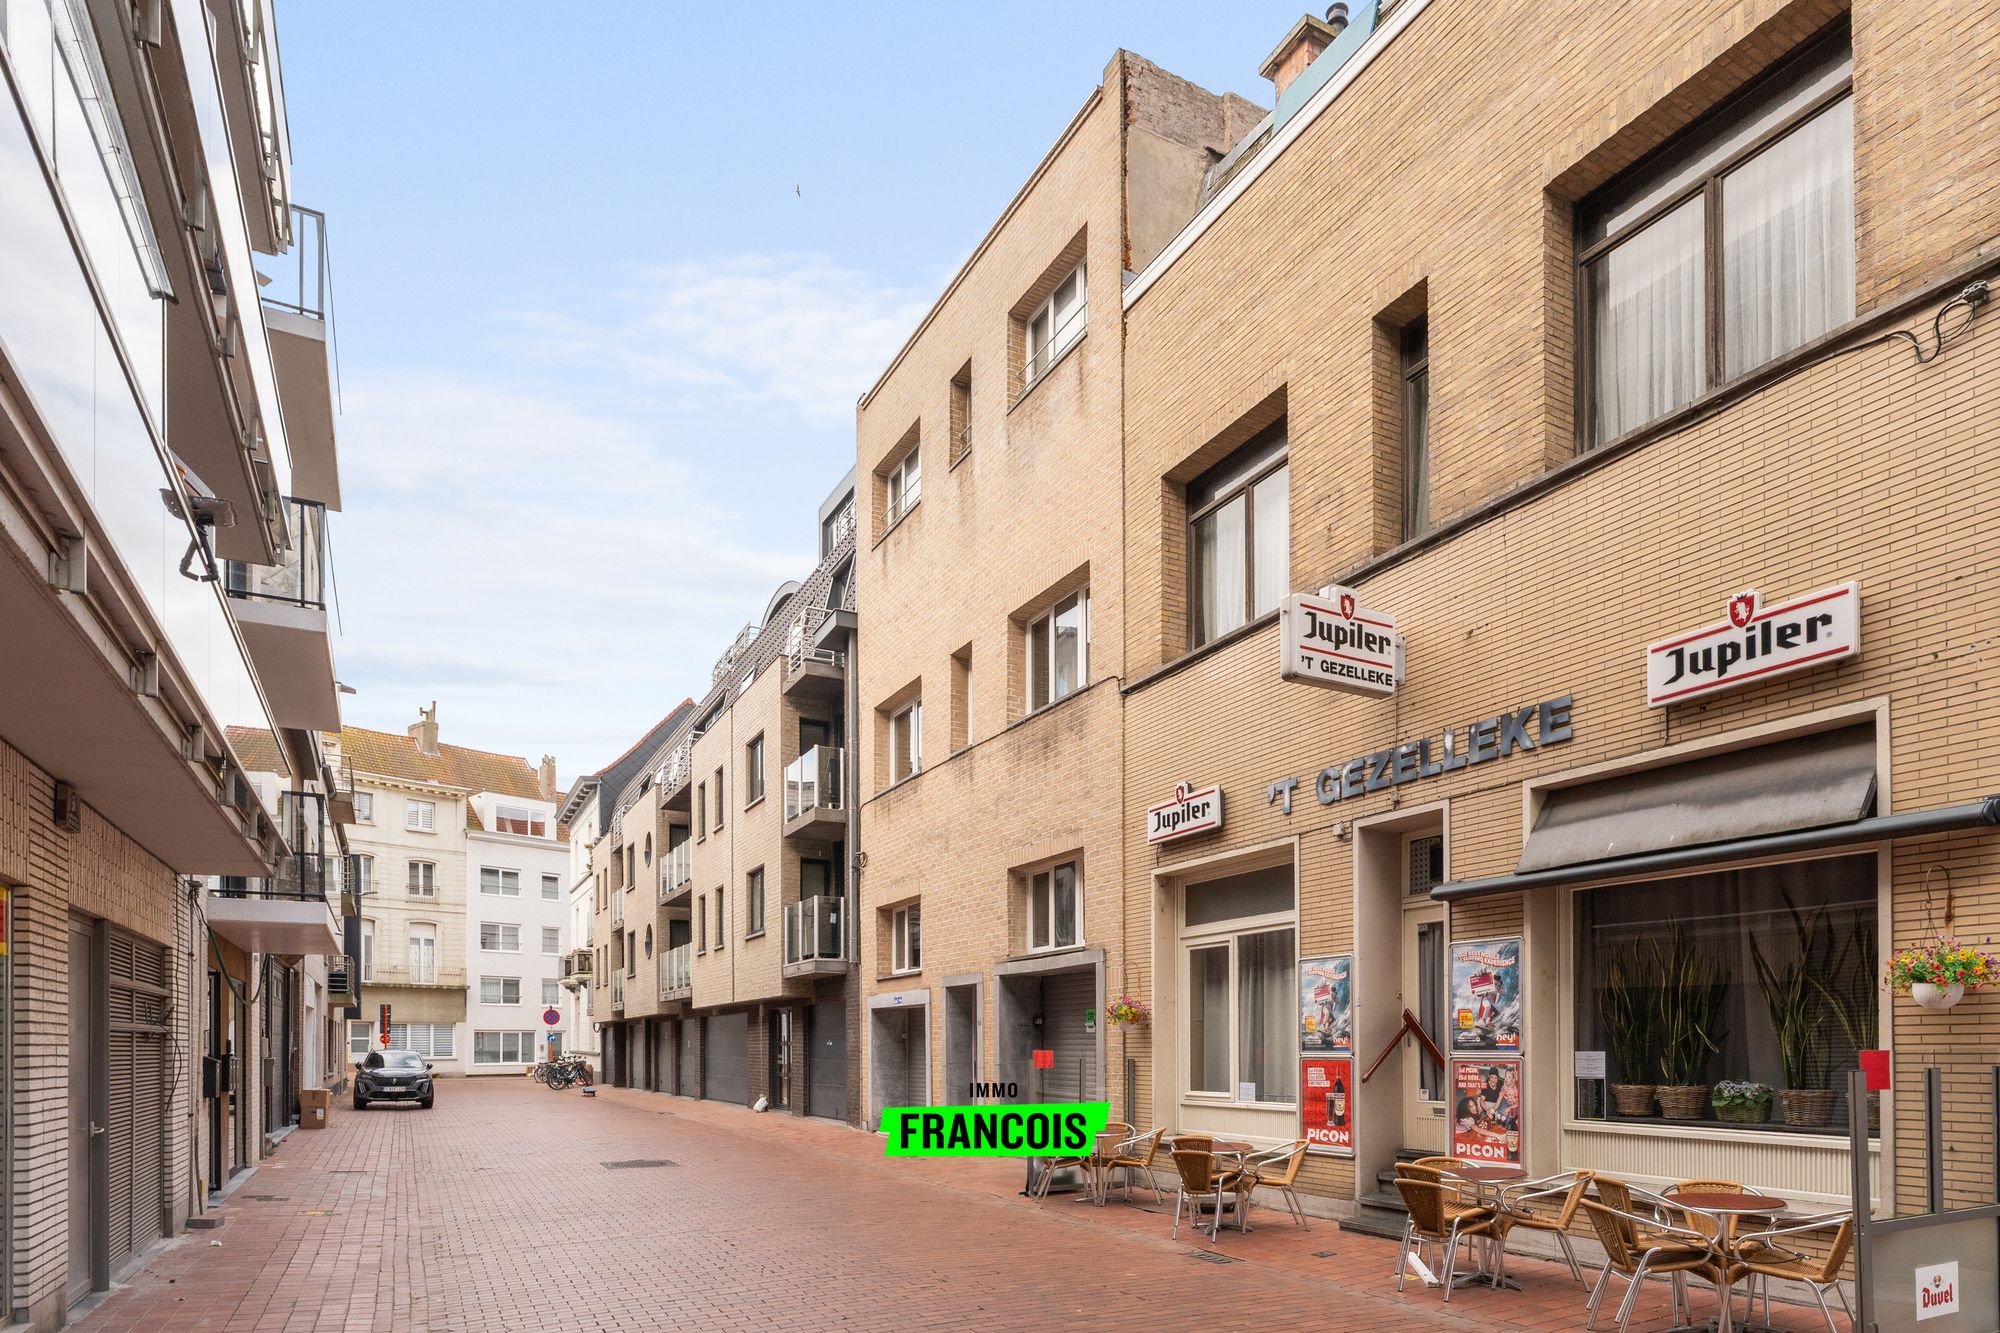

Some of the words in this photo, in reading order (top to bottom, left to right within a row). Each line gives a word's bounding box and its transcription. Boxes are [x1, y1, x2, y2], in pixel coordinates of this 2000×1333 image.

[1303, 611, 1391, 654] Jupiler
[1662, 613, 1832, 686] Jupiler
[1320, 659, 1393, 687] GEZELLEKE
[1316, 693, 1573, 805] GEZELLEKE
[1153, 801, 1210, 832] Jupiler
[1307, 1128, 1349, 1143] PICON
[1456, 1142, 1504, 1158] PICON
[1922, 1282, 1953, 1308] Duvel
